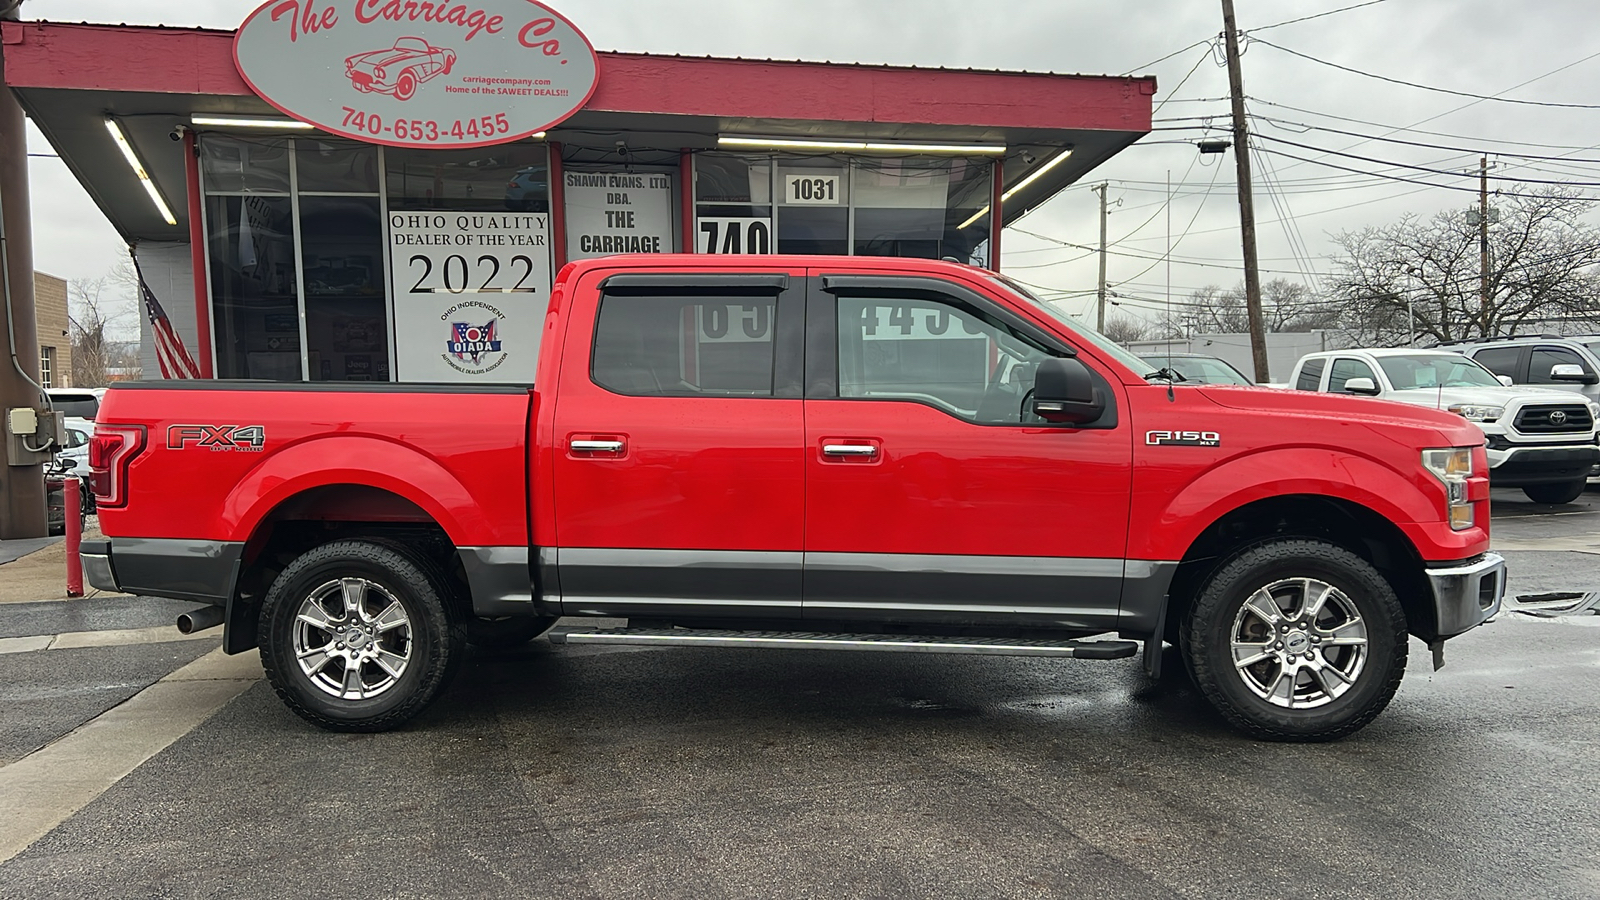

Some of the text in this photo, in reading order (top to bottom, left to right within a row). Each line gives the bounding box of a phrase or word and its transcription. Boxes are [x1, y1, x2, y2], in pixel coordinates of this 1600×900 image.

[271, 0, 568, 65] The Carriage Co.
[462, 75, 551, 87] carriagecompany.com
[445, 85, 569, 97] Home of the SAWEET DEALS!!!
[341, 105, 510, 142] 740-653-4455
[566, 174, 607, 188] SHAWN
[649, 177, 670, 190] LTD.
[791, 178, 834, 201] 1031
[606, 192, 632, 205] DBA.
[391, 215, 547, 232] OHIO QUALITY
[604, 210, 636, 229] THE
[394, 233, 545, 246] DEALER OF THE YEAR
[580, 234, 661, 253] CARRIAGE
[700, 220, 769, 255] 740
[408, 254, 536, 294] 2022
[440, 300, 507, 321] OHIO INDEPENDENT
[453, 340, 493, 352] OIADA
[441, 353, 466, 374] AUTOMOBILE
[465, 367, 486, 375] DEALERS
[166, 424, 265, 450] FX4
